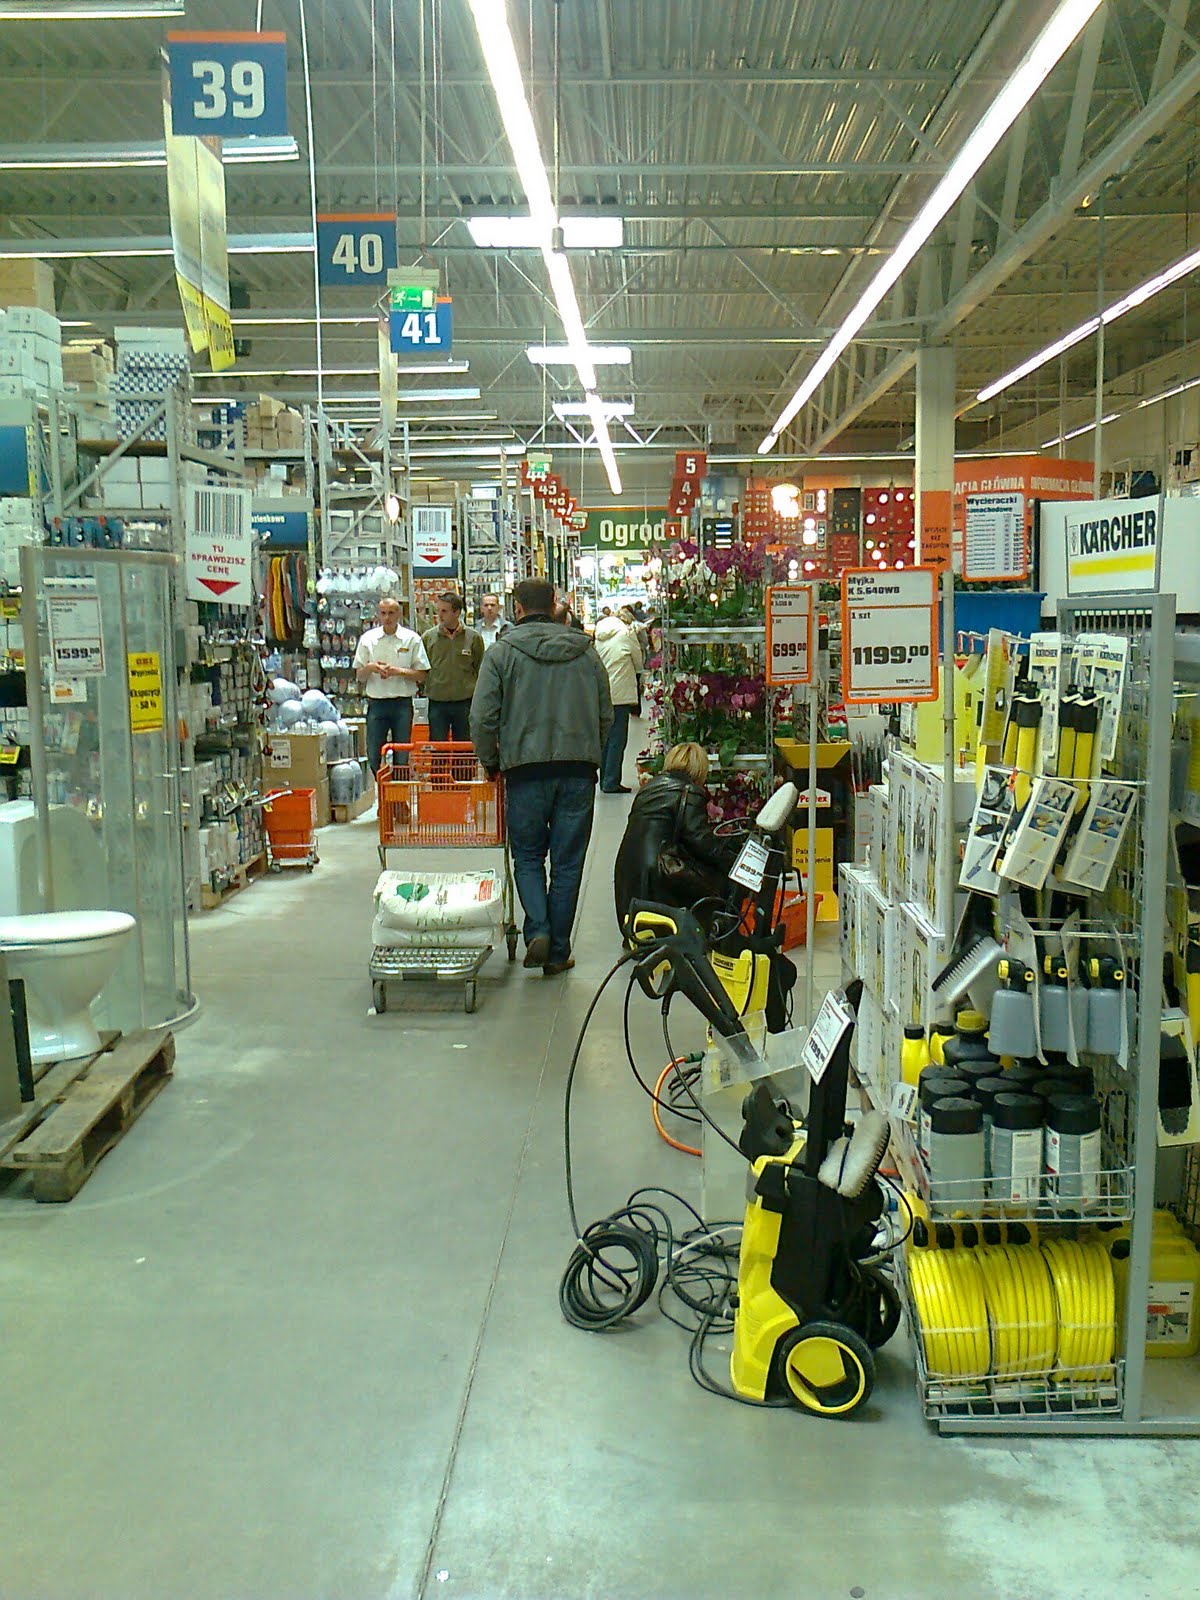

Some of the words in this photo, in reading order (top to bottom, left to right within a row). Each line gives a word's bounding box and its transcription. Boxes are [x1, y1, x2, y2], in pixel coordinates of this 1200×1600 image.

[192, 60, 265, 119] 39
[332, 233, 383, 274] 40
[401, 313, 441, 344] 41
[685, 457, 696, 474] 5
[526, 470, 547, 482] 44
[682, 481, 692, 496] 4
[966, 496, 1018, 506] Wycieraczki
[600, 518, 667, 548] Ogród
[670, 526, 676, 536] 1
[1080, 509, 1156, 556] KÄRCHER
[212, 545, 224, 553] TU
[191, 553, 246, 565] SPRAWDZISZ
[207, 566, 229, 575] CENĘ
[847, 576, 875, 585] Myjka
[848, 588, 855, 596] K
[772, 642, 807, 657] 699,00
[852, 645, 929, 665] 1199,00
[800, 794, 828, 803] Paex
